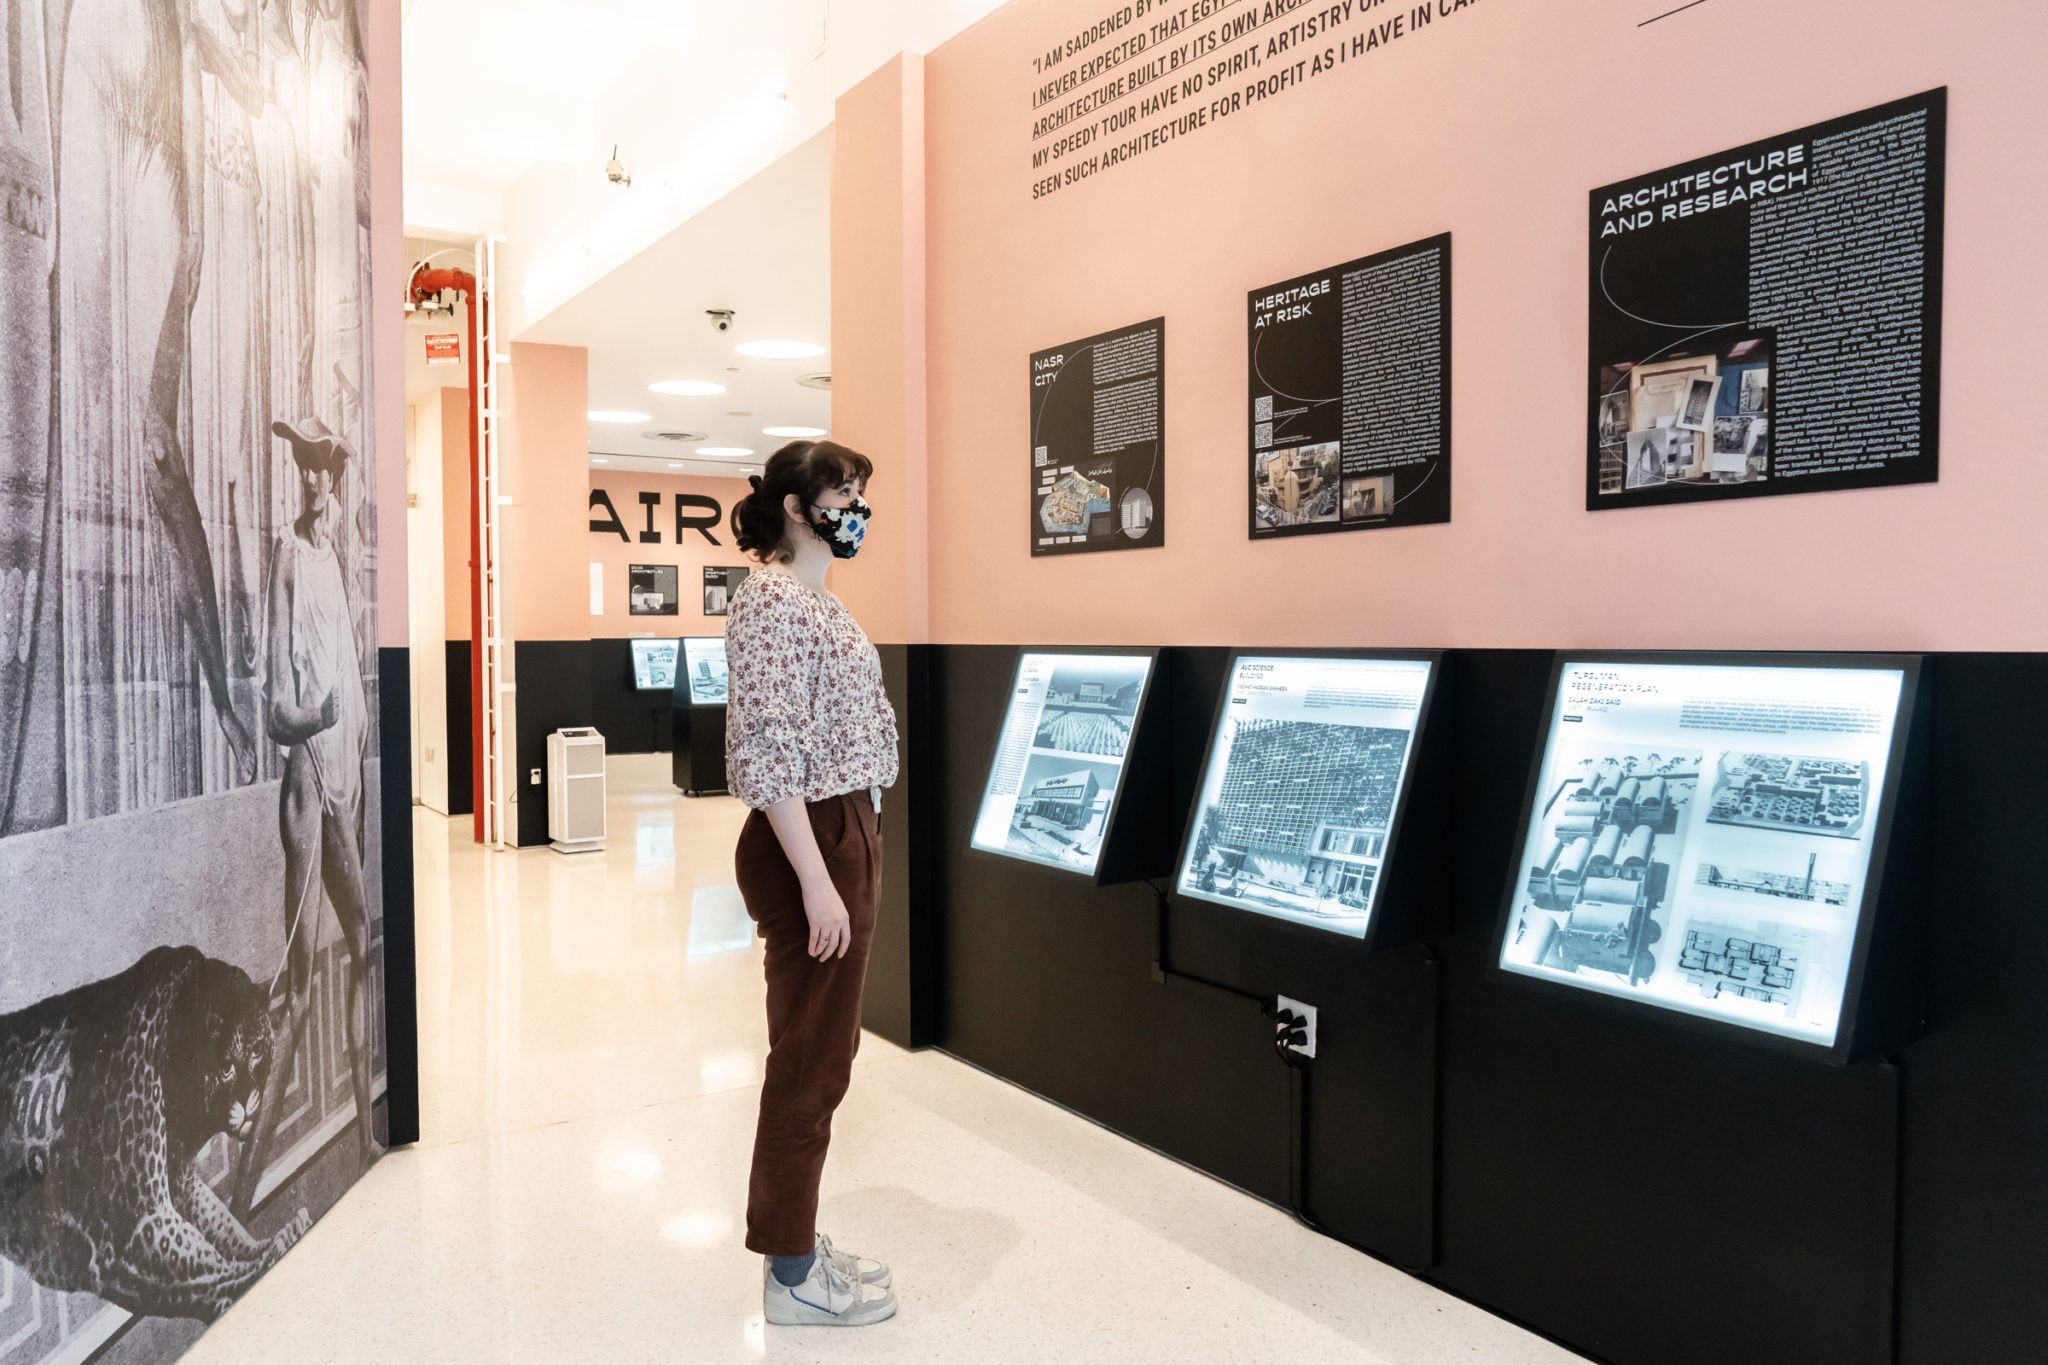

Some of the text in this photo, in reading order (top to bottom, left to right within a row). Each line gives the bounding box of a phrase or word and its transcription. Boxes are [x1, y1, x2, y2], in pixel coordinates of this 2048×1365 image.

[1032, 91, 1036, 108] I
[1039, 70, 1077, 104] NEVER
[1080, 33, 1146, 82] EXPECTED
[1150, 9, 1188, 44] THAT
[1044, 45, 1063, 71] AM
[1066, 6, 1132, 58] SADDENED
[1136, 0, 1152, 18] BY
[1032, 77, 1125, 139] ARCHITECTURE
[1128, 55, 1167, 91] BUILT
[1170, 44, 1188, 70] BY
[1193, 30, 1217, 59] ITS
[1221, 8, 1257, 43] OWN
[1032, 146, 1050, 169] MY
[1053, 123, 1099, 160] SPEEDY
[1101, 105, 1137, 136] TOUR
[1140, 84, 1178, 119] HAVE
[1182, 73, 1202, 99] NO
[1207, 44, 1261, 86] SPIRIT,
[1266, 0, 1352, 59] ARTISTRY
[1032, 172, 1061, 200] SEEN
[1065, 156, 1098, 186] SUCH
[1101, 106, 1207, 170] ARCHITECTURE
[1211, 91, 1241, 122] FOR
[1246, 60, 1306, 106] PROFIT
[1311, 48, 1335, 77] AS
[1340, 42, 1346, 63] I
[1352, 14, 1404, 58] HAVE
[1411, 1, 1431, 31] IN
[1600, 167, 1807, 238] AND RESEARCH
[1601, 143, 1804, 217] ARCHITECTURE
[1254, 278, 1330, 312] HERITAGE
[1254, 301, 1311, 329] AT RISK
[1034, 353, 1063, 371] NASR
[1035, 370, 1057, 387] CITY
[589, 488, 743, 546] AIR
